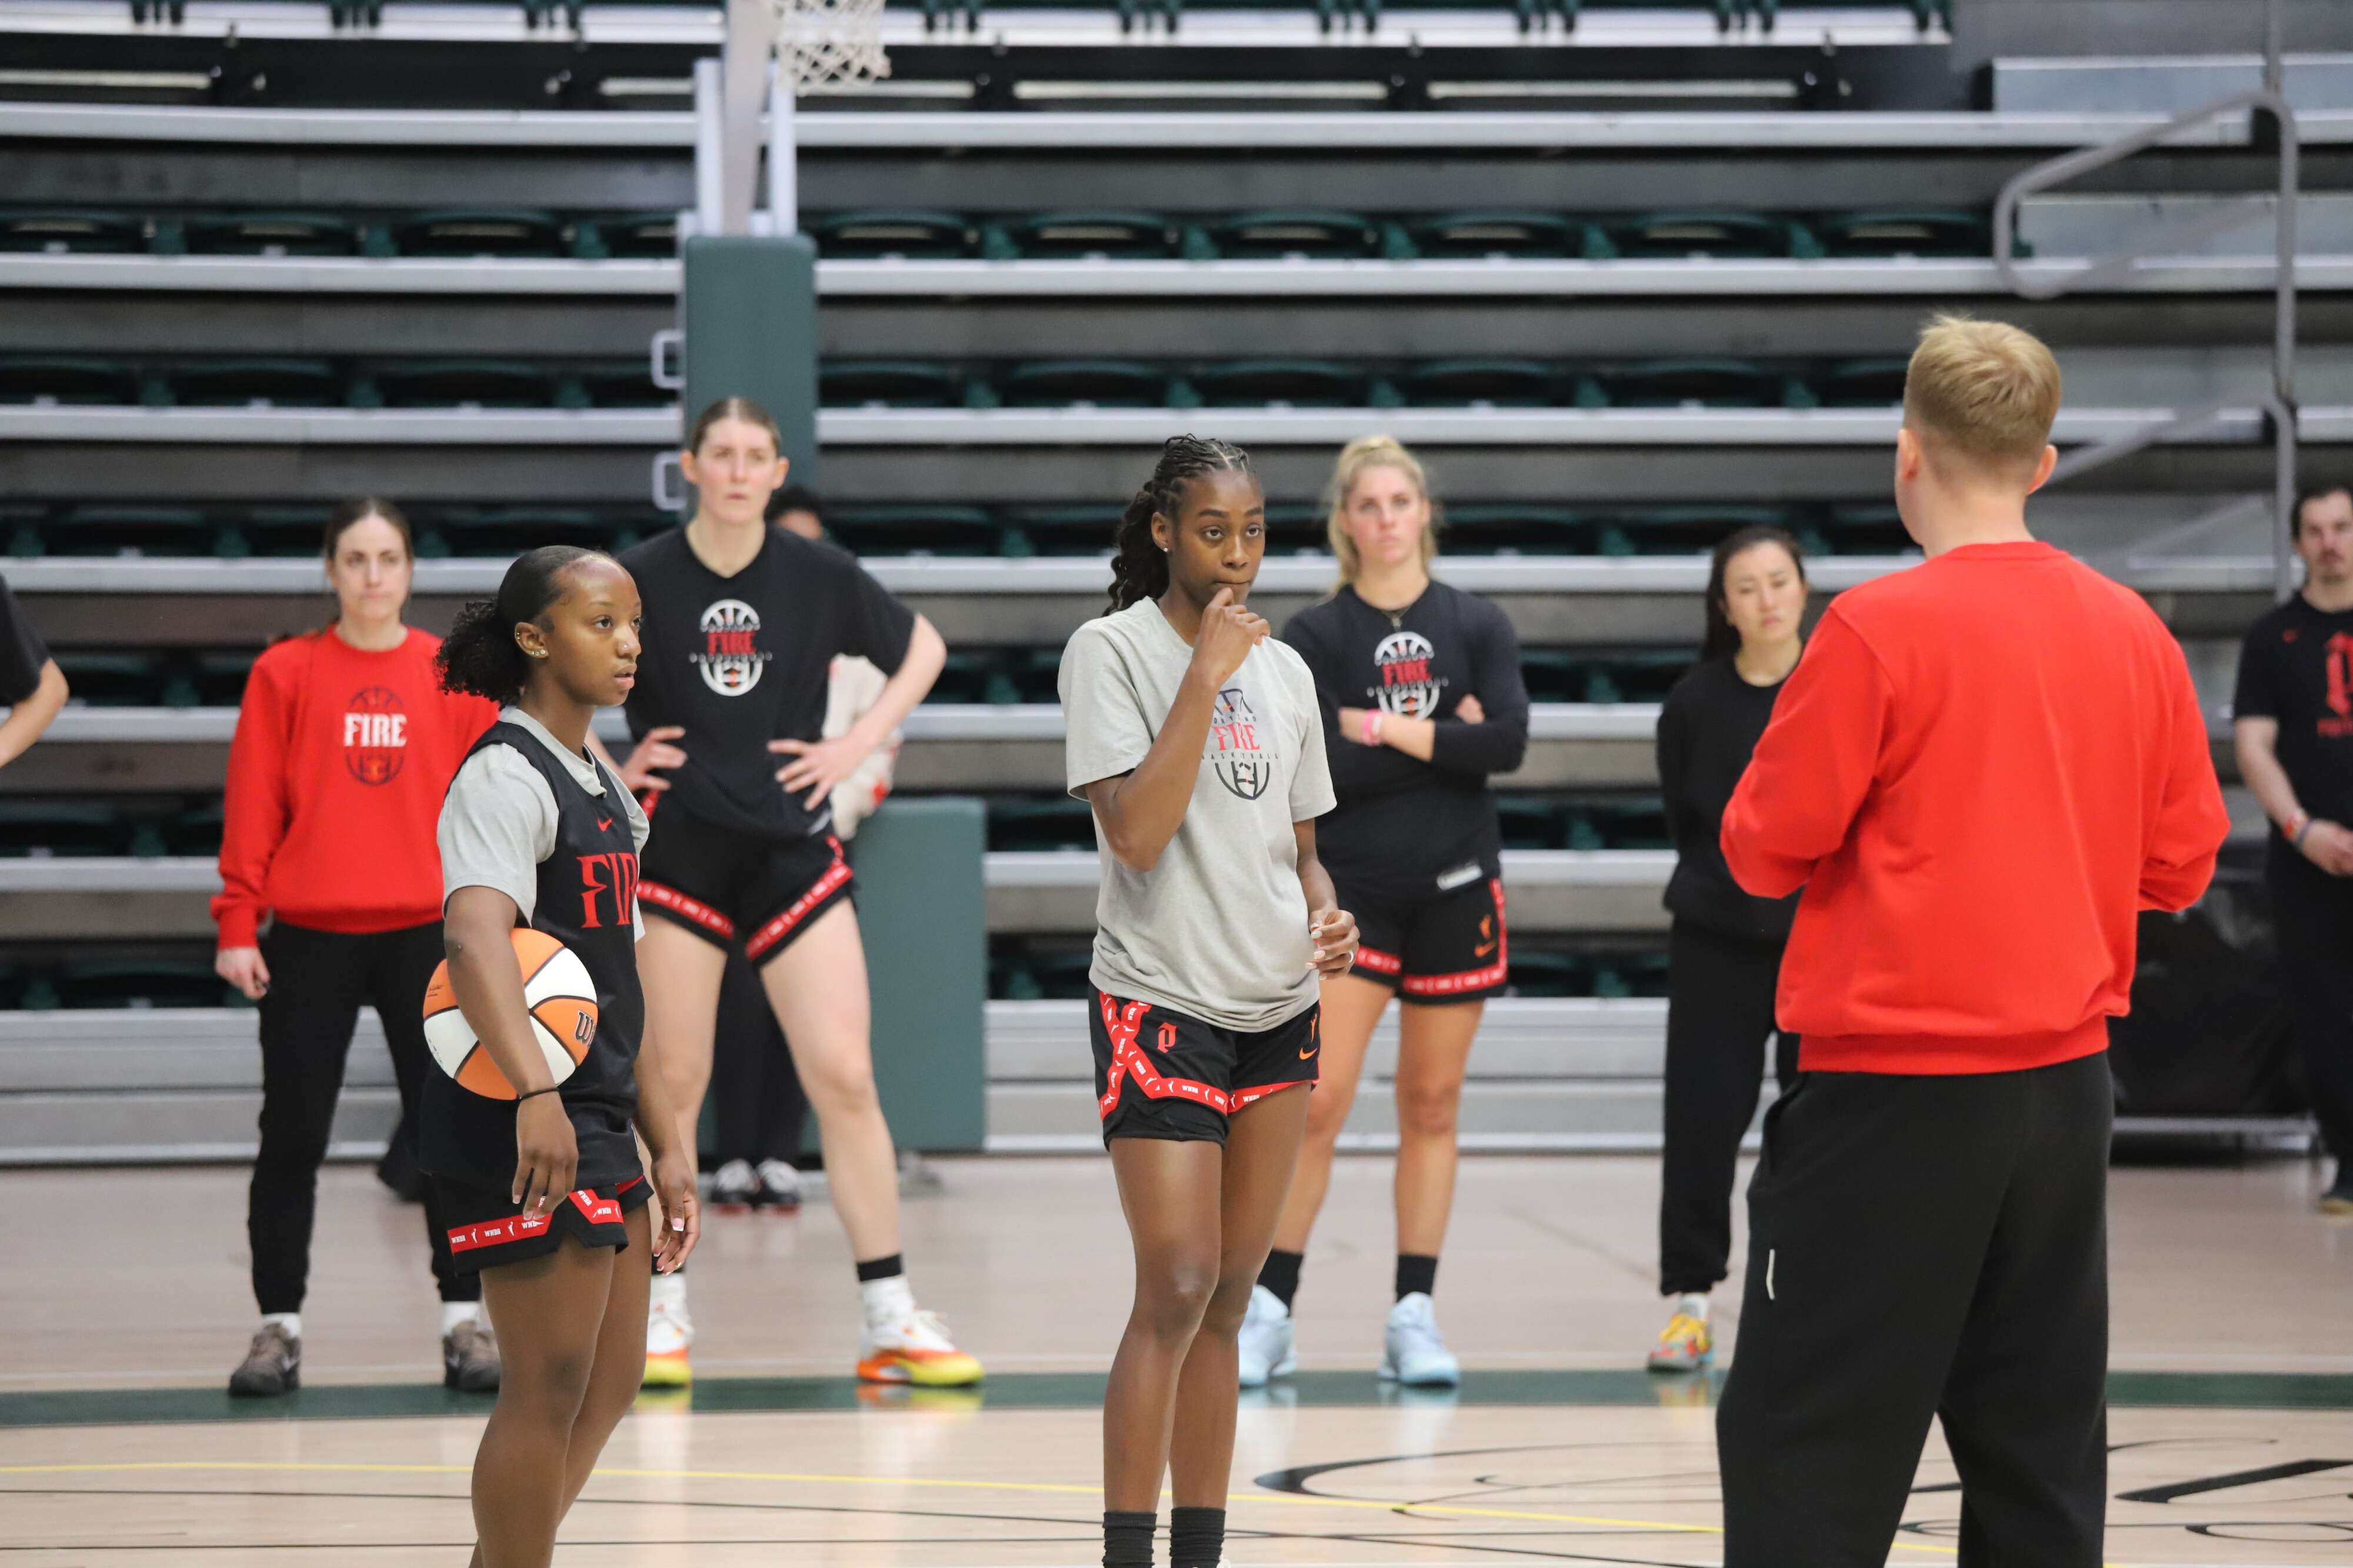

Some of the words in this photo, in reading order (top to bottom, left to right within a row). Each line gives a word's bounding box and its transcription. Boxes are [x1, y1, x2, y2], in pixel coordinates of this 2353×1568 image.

[344, 712, 408, 748] FIRE
[576, 852, 638, 928] FIR
[451, 1235, 466, 1244] WNBA
[484, 1227, 501, 1237] WNBA
